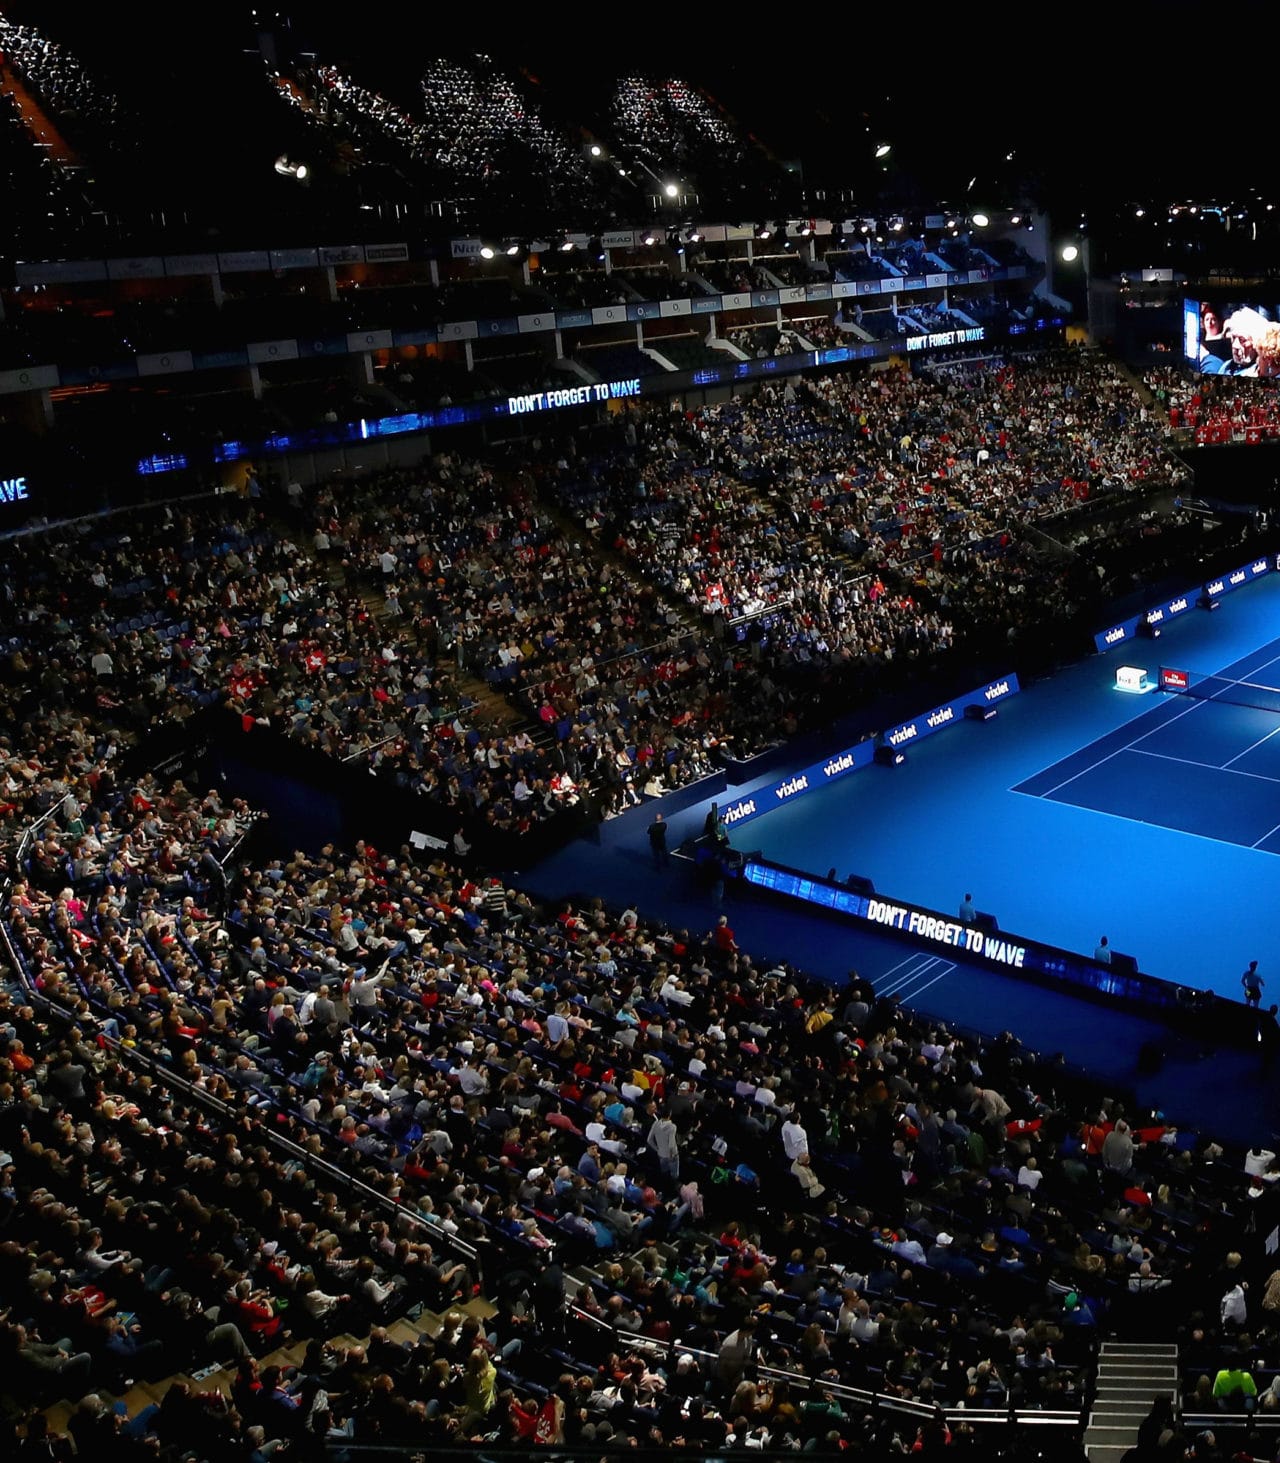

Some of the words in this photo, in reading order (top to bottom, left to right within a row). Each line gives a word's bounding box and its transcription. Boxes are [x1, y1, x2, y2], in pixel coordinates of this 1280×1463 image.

[956, 330, 966, 343] TO
[508, 393, 544, 415] DON'T
[547, 386, 591, 408] FORGET
[593, 383, 609, 400] TO
[610, 379, 641, 398] WAVE
[776, 775, 808, 800] vixlet
[824, 753, 854, 777] vixlet
[889, 723, 918, 746] vixlet
[927, 706, 953, 728] vixlet
[985, 680, 1009, 701] vixlet
[867, 899, 907, 929] DON'T
[909, 912, 962, 946] FORGET
[965, 928, 983, 953] TO
[985, 937, 1025, 968] WAVE
